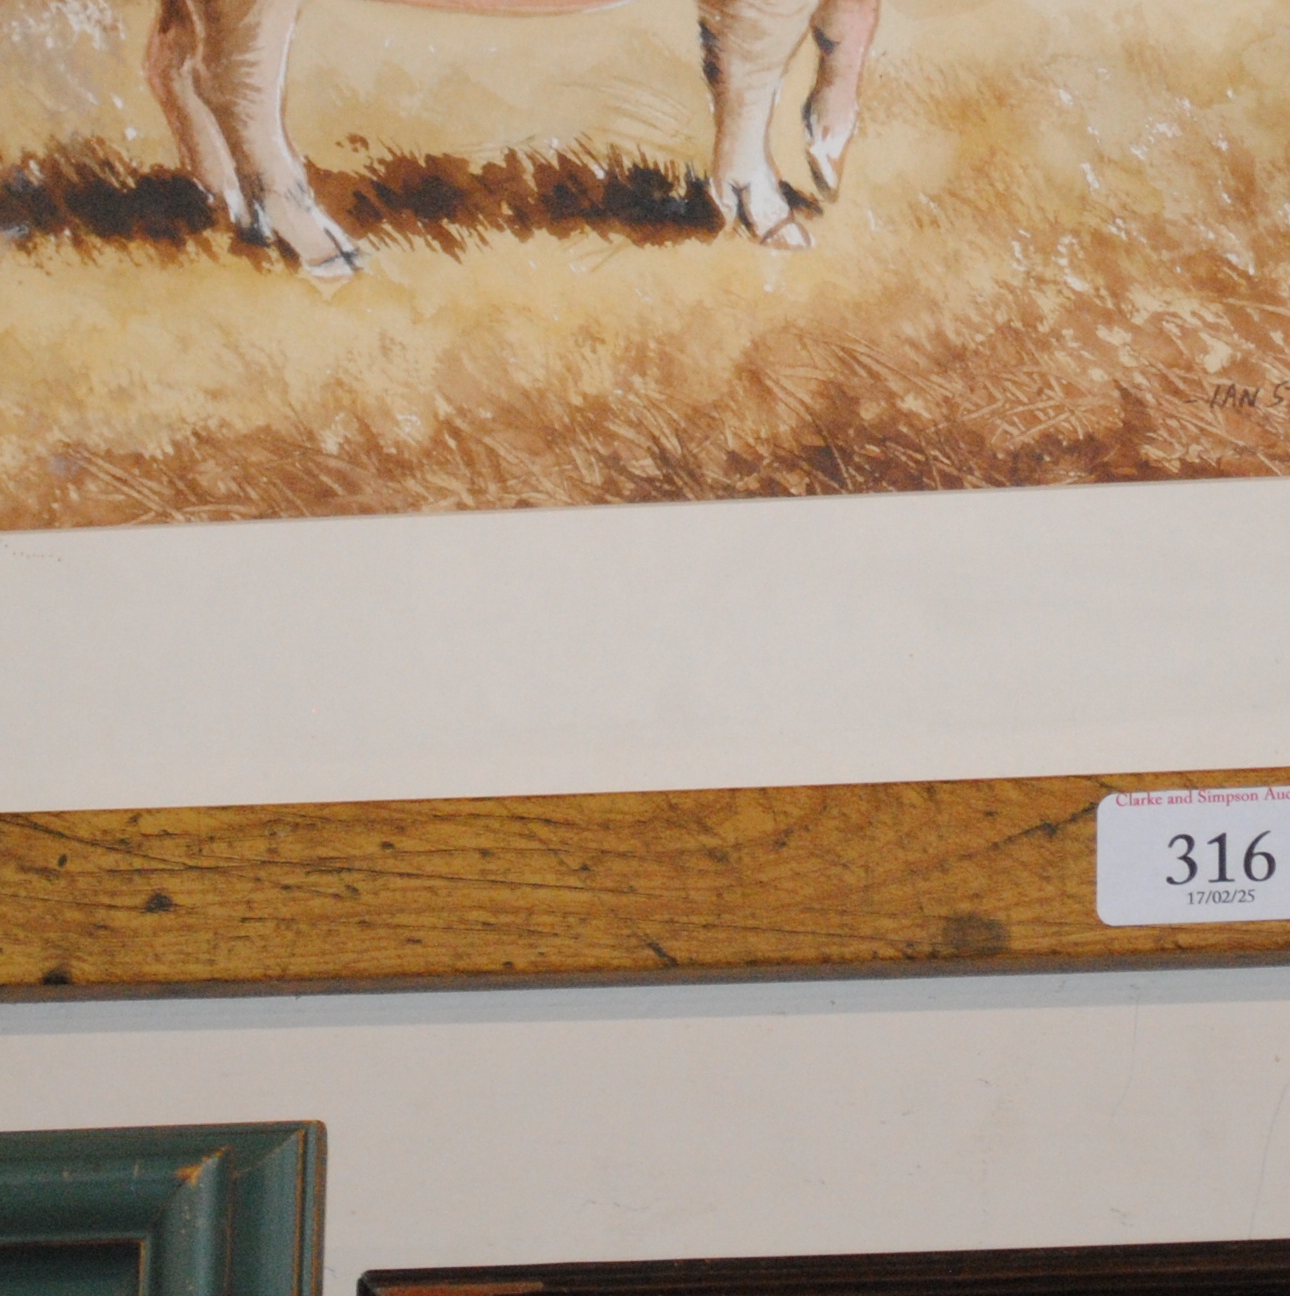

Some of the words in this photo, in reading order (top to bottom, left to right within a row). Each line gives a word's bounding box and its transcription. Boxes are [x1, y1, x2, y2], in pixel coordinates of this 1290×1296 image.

[1115, 791, 1163, 808] Clarke
[1167, 789, 1193, 805] and
[1197, 788, 1259, 807] Simpson
[1166, 830, 1277, 885] 316
[1187, 889, 1256, 905] 17/02/25
